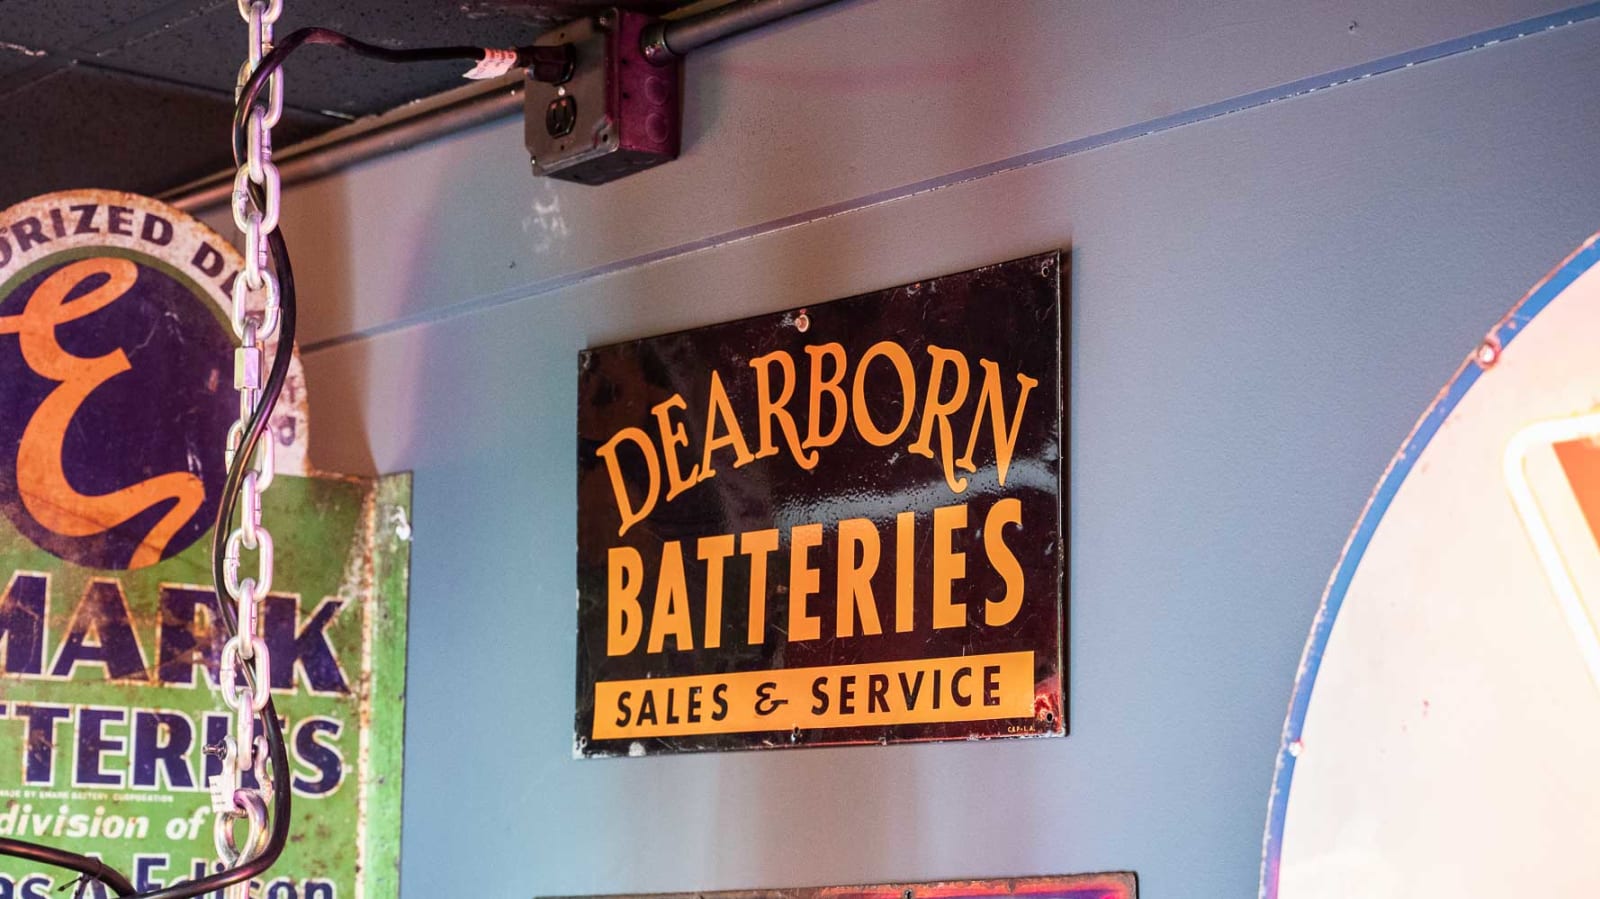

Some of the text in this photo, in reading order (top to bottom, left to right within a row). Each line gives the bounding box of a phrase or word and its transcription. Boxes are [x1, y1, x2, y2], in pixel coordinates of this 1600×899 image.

[596, 340, 1038, 538] DEARBORN
[606, 498, 1025, 657] BATTERIES
[615, 666, 1001, 728] SALES & SERVICE
[0, 699, 348, 798] TERIS
[0, 804, 211, 840] division of
